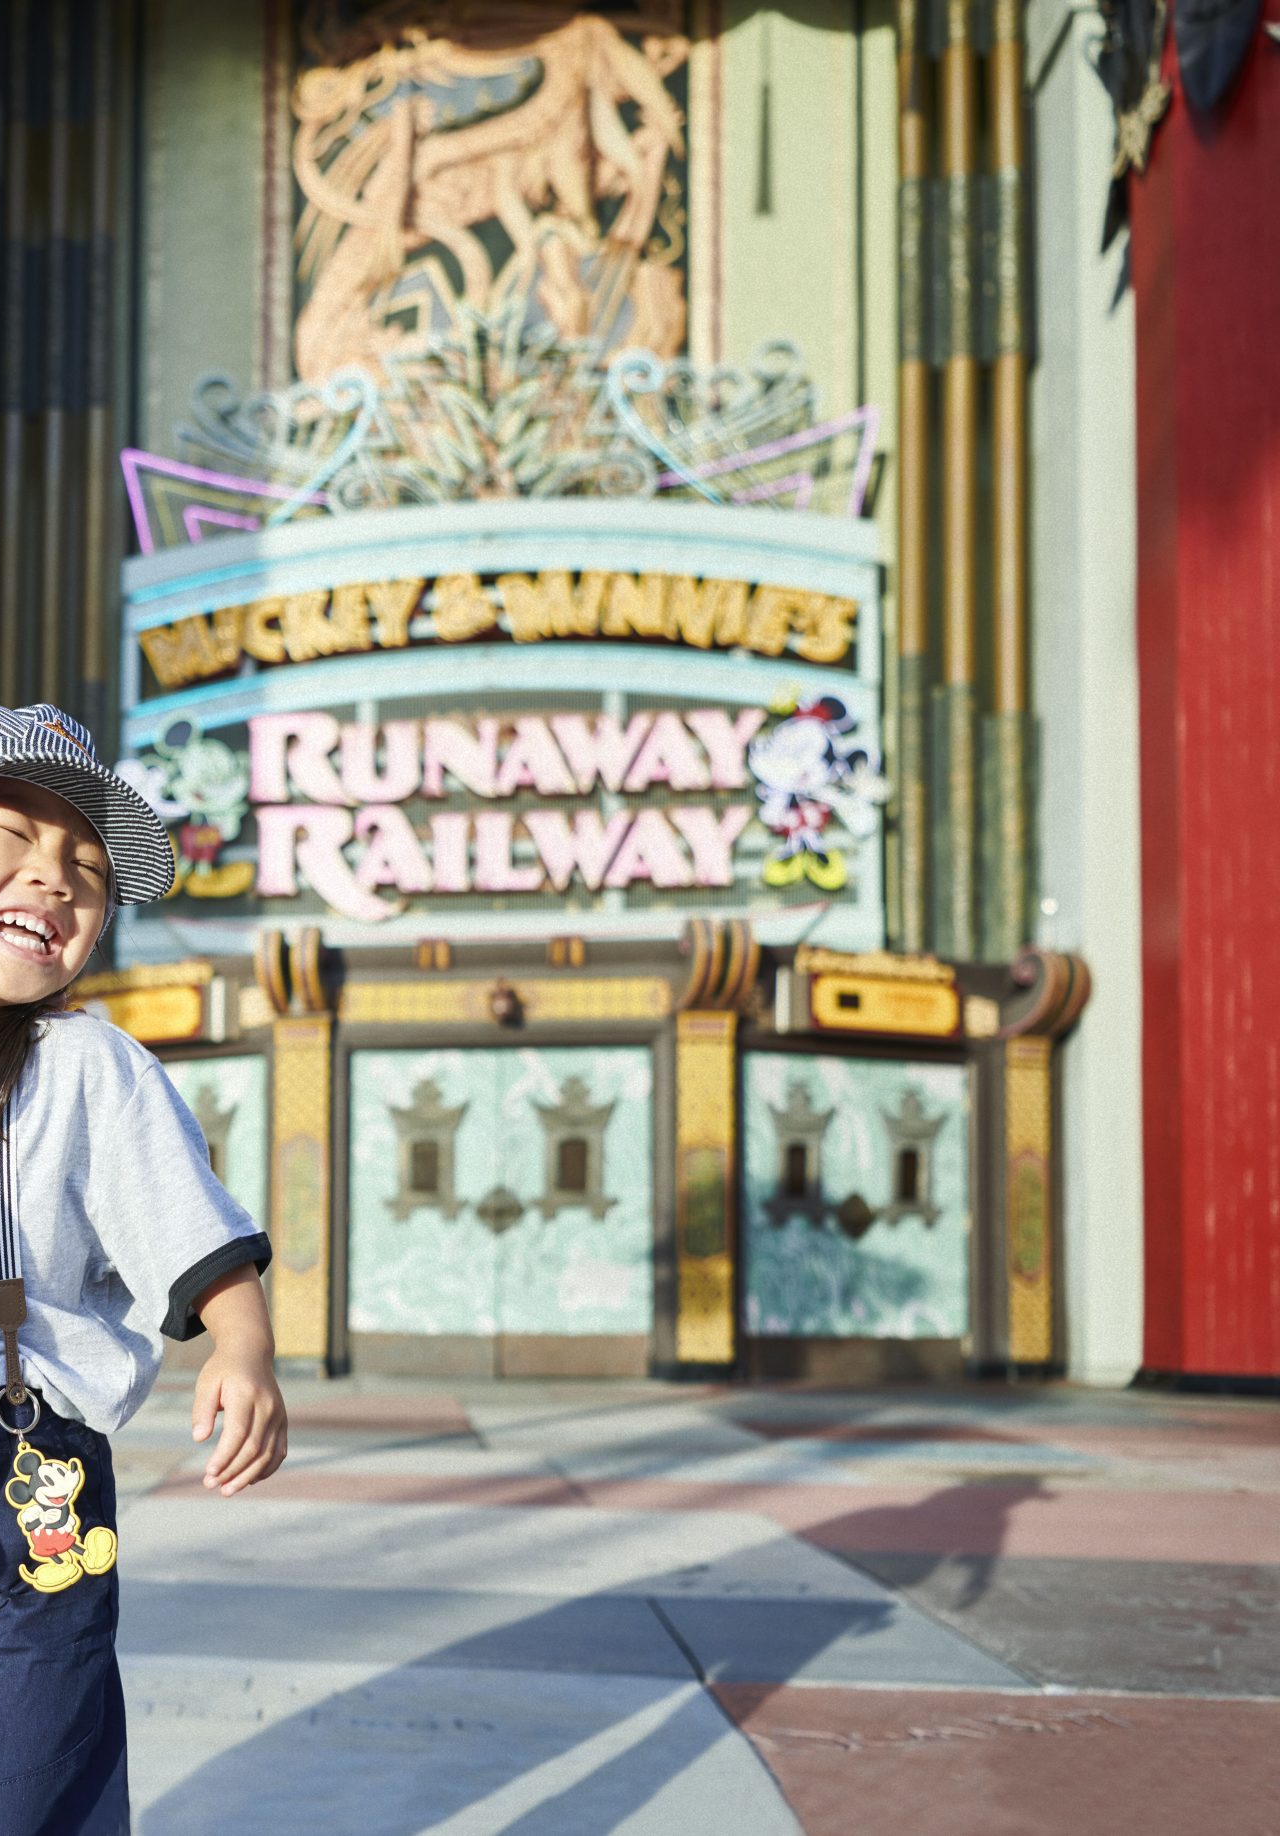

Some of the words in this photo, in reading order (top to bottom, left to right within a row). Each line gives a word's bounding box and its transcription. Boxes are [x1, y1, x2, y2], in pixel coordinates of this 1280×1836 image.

[138, 577, 426, 689] MICKEY
[433, 571, 497, 643] &
[249, 708, 768, 806] RUNAWAY
[255, 803, 755, 922] RAILWAY
